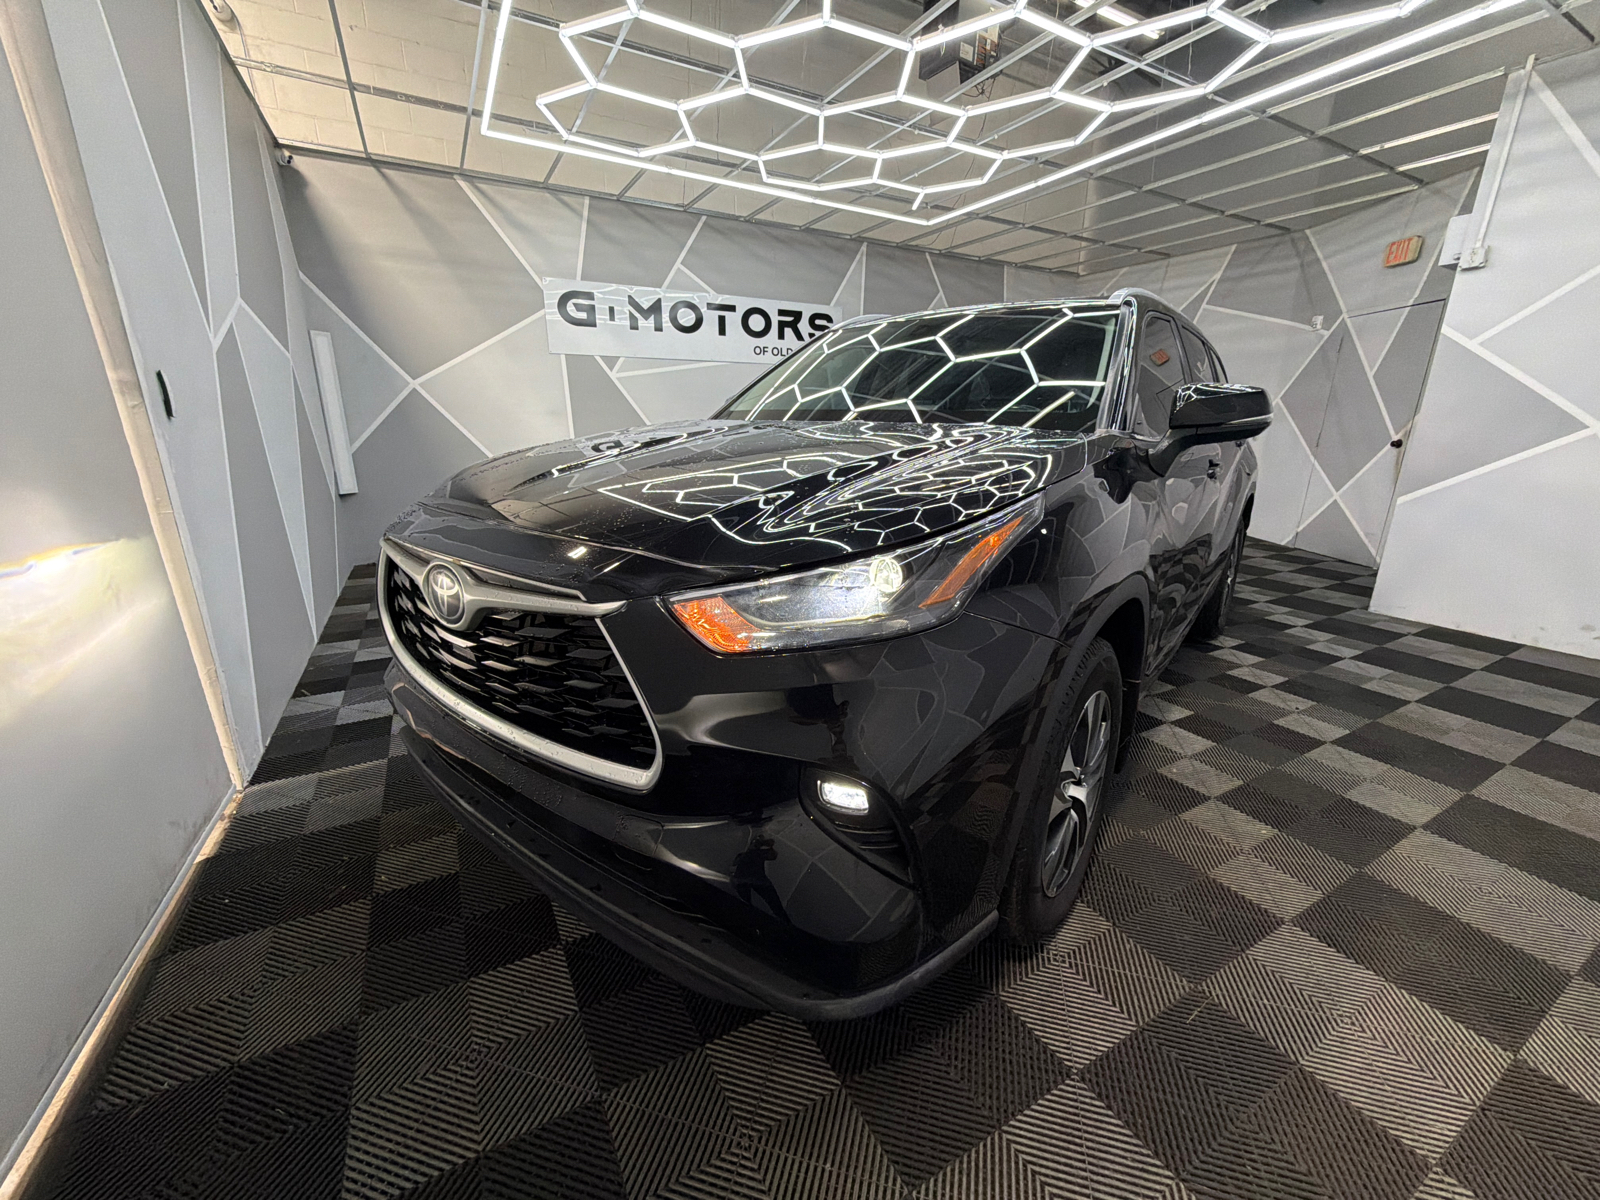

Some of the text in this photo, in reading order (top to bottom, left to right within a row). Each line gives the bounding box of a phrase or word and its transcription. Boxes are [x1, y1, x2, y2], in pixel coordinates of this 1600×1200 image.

[1385, 237, 1414, 264] EXIT
[627, 294, 834, 342] MOTORS
[753, 345, 769, 356] OF
